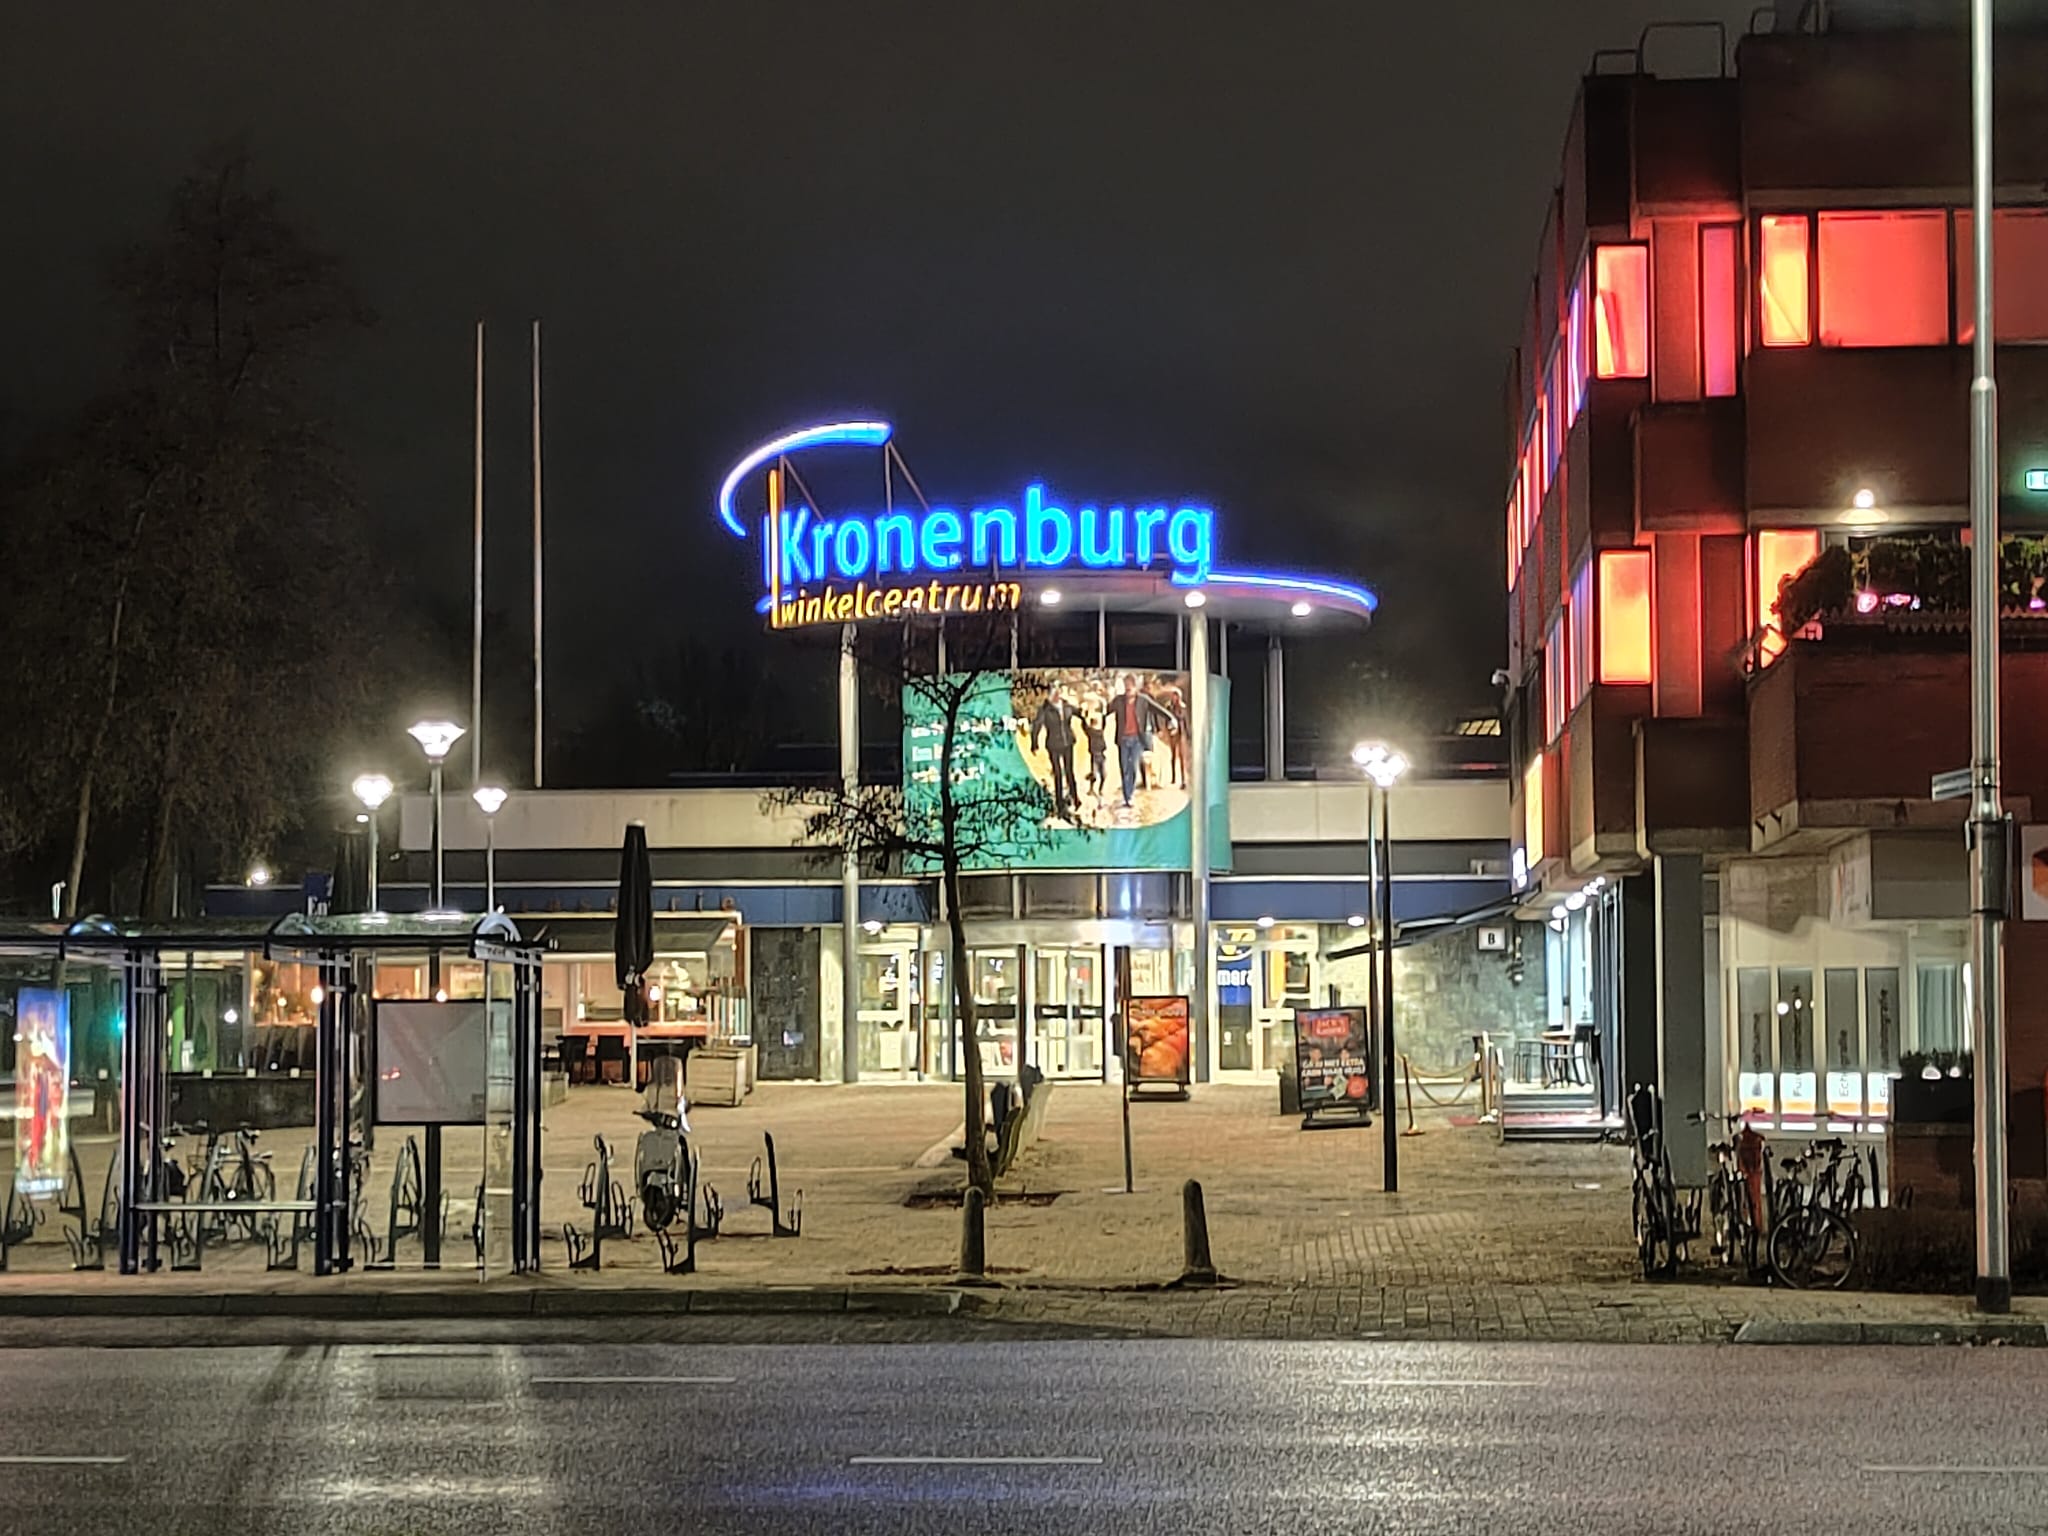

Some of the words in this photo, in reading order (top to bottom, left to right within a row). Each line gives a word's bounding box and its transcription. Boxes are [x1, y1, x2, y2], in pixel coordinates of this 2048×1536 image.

[779, 485, 1214, 583] Kronenburg
[780, 579, 1022, 625] winkelcentrum
[1487, 932, 1496, 945] B
